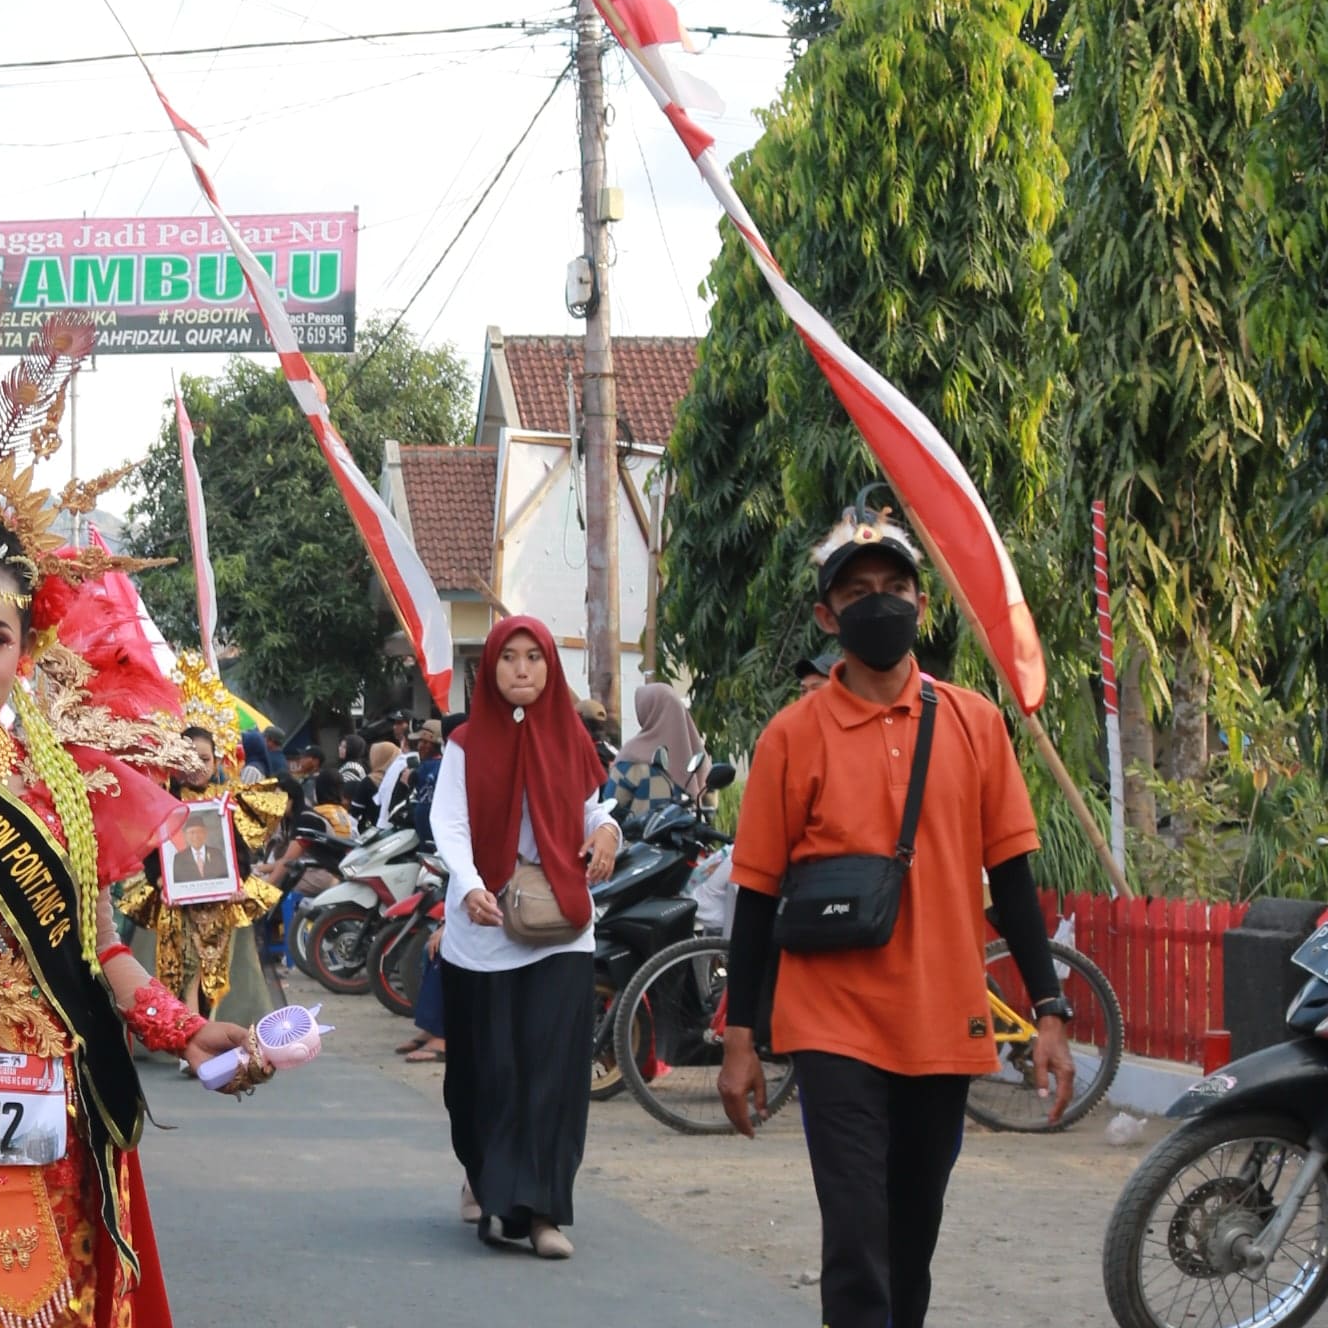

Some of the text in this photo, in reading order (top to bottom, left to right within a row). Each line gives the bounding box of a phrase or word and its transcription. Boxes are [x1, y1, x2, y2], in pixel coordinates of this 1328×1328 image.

[73, 223, 145, 249] Jadi
[289, 218, 347, 243] NU
[0, 311, 117, 328] ELEKTIKA
[172, 308, 250, 325] ROBOTIK
[307, 312, 345, 324] Person
[185, 327, 252, 346] QUR'AN
[307, 326, 326, 345] 619
[328, 326, 347, 345] 545
[0, 840, 67, 927] PONTANG
[48, 917, 71, 949] 05
